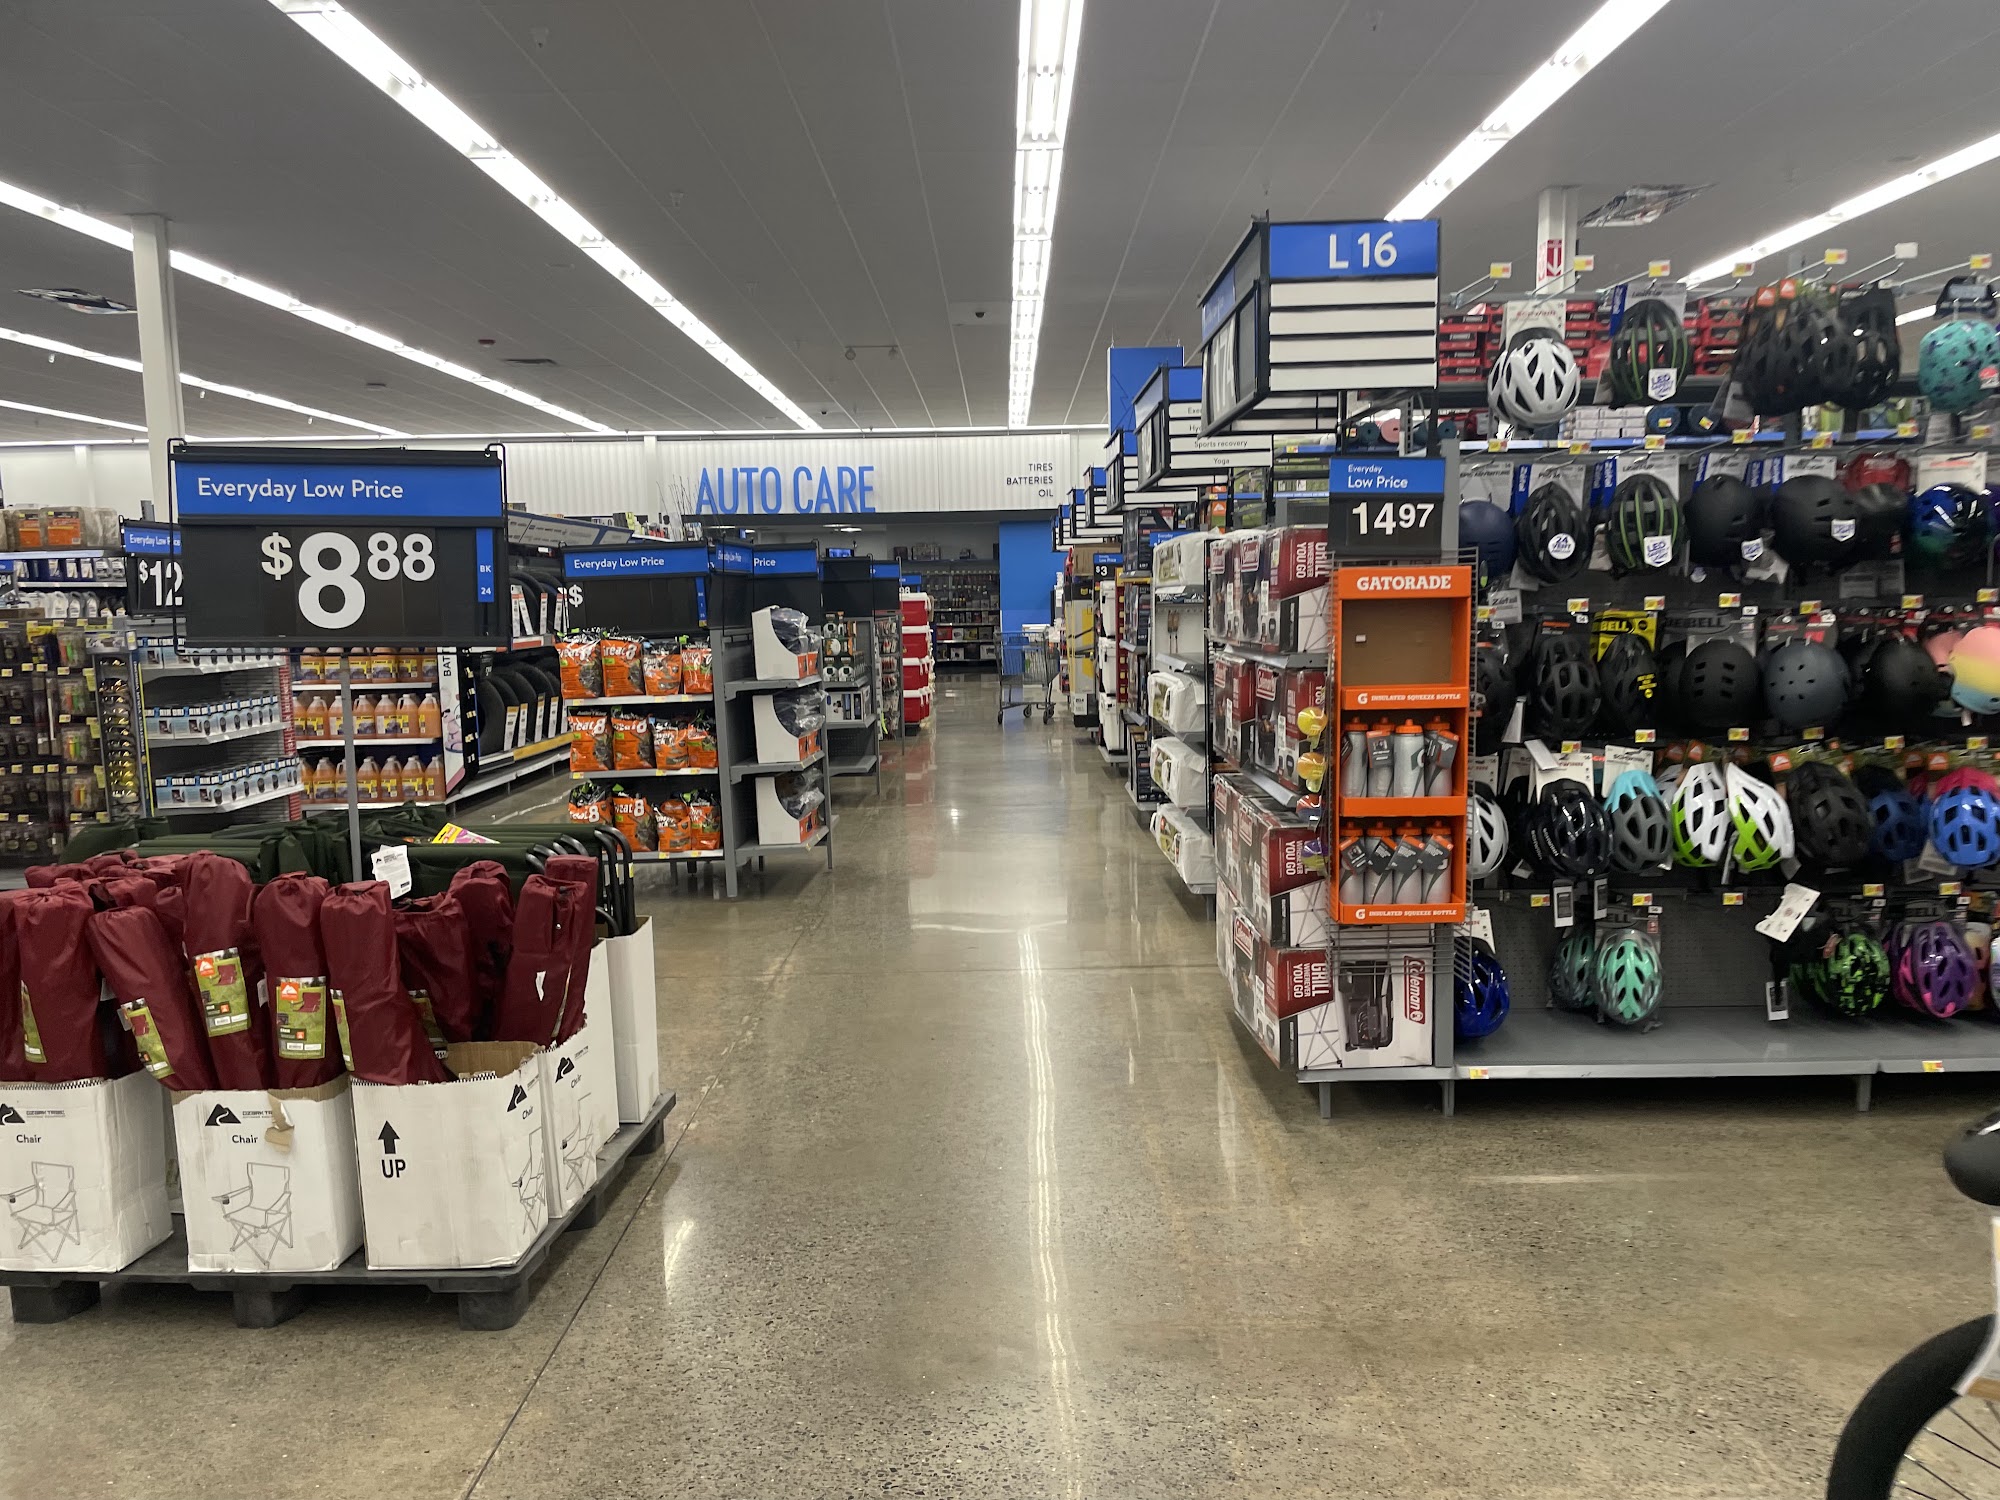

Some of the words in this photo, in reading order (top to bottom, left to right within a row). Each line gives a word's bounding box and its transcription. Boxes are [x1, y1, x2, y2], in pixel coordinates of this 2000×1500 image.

[1329, 233, 1350, 269] L
[1357, 230, 1398, 269] 16
[1194, 440, 1217, 449] Sports
[1217, 440, 1248, 448] recovery
[1028, 462, 1053, 471] TIRES
[1213, 457, 1230, 465] Yoga
[1347, 464, 1383, 475] Everyday
[1006, 475, 1053, 485] BATTERIES
[1347, 475, 1373, 489] Low
[1376, 475, 1409, 489] Price
[197, 477, 297, 503] Everyday
[303, 479, 345, 498] Low
[351, 480, 404, 499] Price
[695, 466, 783, 515] AUTO
[792, 465, 876, 514] CARE
[1038, 488, 1054, 497] OIL
[129, 533, 156, 547] Everyday
[1296, 541, 1307, 566] YOU
[479, 564, 492, 573] BK
[574, 557, 617, 570] Everyday
[619, 557, 639, 568] Low
[640, 556, 665, 567] Price
[753, 557, 776, 567] Price
[1295, 565, 1307, 579] GO
[1356, 575, 1453, 591] GATORADE
[480, 586, 492, 595] 24
[1600, 620, 1630, 632] BELL
[1370, 694, 1406, 702] INSULATED
[1406, 693, 1436, 701] SQUEEZE
[588, 805, 600, 823] 8
[633, 799, 645, 817] 8
[1285, 840, 1296, 860] YOU
[1285, 859, 1296, 876] GO
[1404, 909, 1432, 917] SQUEEZE
[1608, 912, 1631, 923] ELL
[1293, 963, 1304, 985] YOU
[1303, 962, 1311, 997] WHEREVER
[1311, 962, 1330, 997] GRILL
[1293, 984, 1304, 998] GO
[1408, 959, 1425, 1014] Coleman
[16, 1134, 42, 1144] Chair
[231, 1134, 259, 1145] Chair
[381, 1159, 407, 1179] UP
